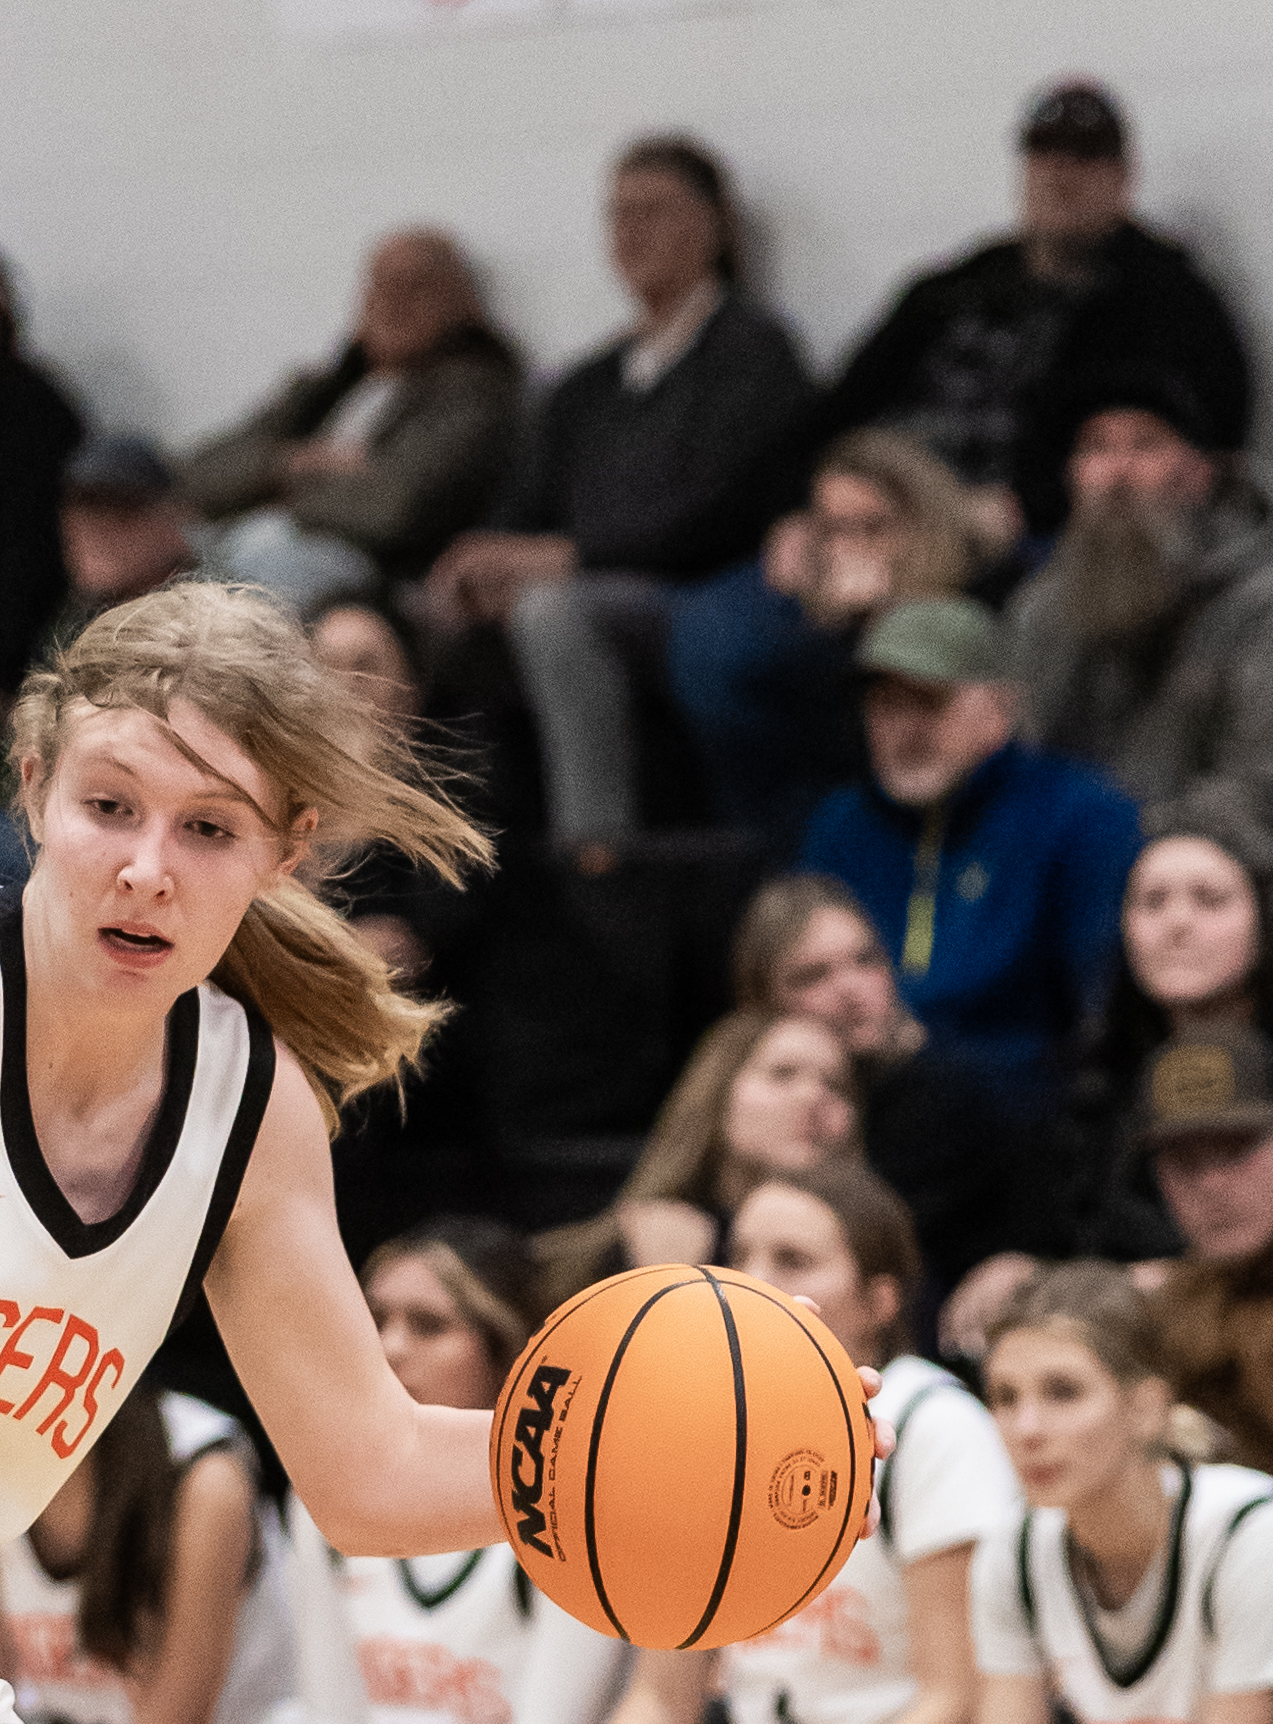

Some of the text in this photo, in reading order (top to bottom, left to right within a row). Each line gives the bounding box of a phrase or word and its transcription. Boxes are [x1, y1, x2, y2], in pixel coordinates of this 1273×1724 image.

[511, 1364, 573, 1560] NCAA
[548, 1426, 564, 1481] GAME
[558, 1375, 583, 1422] BALL
